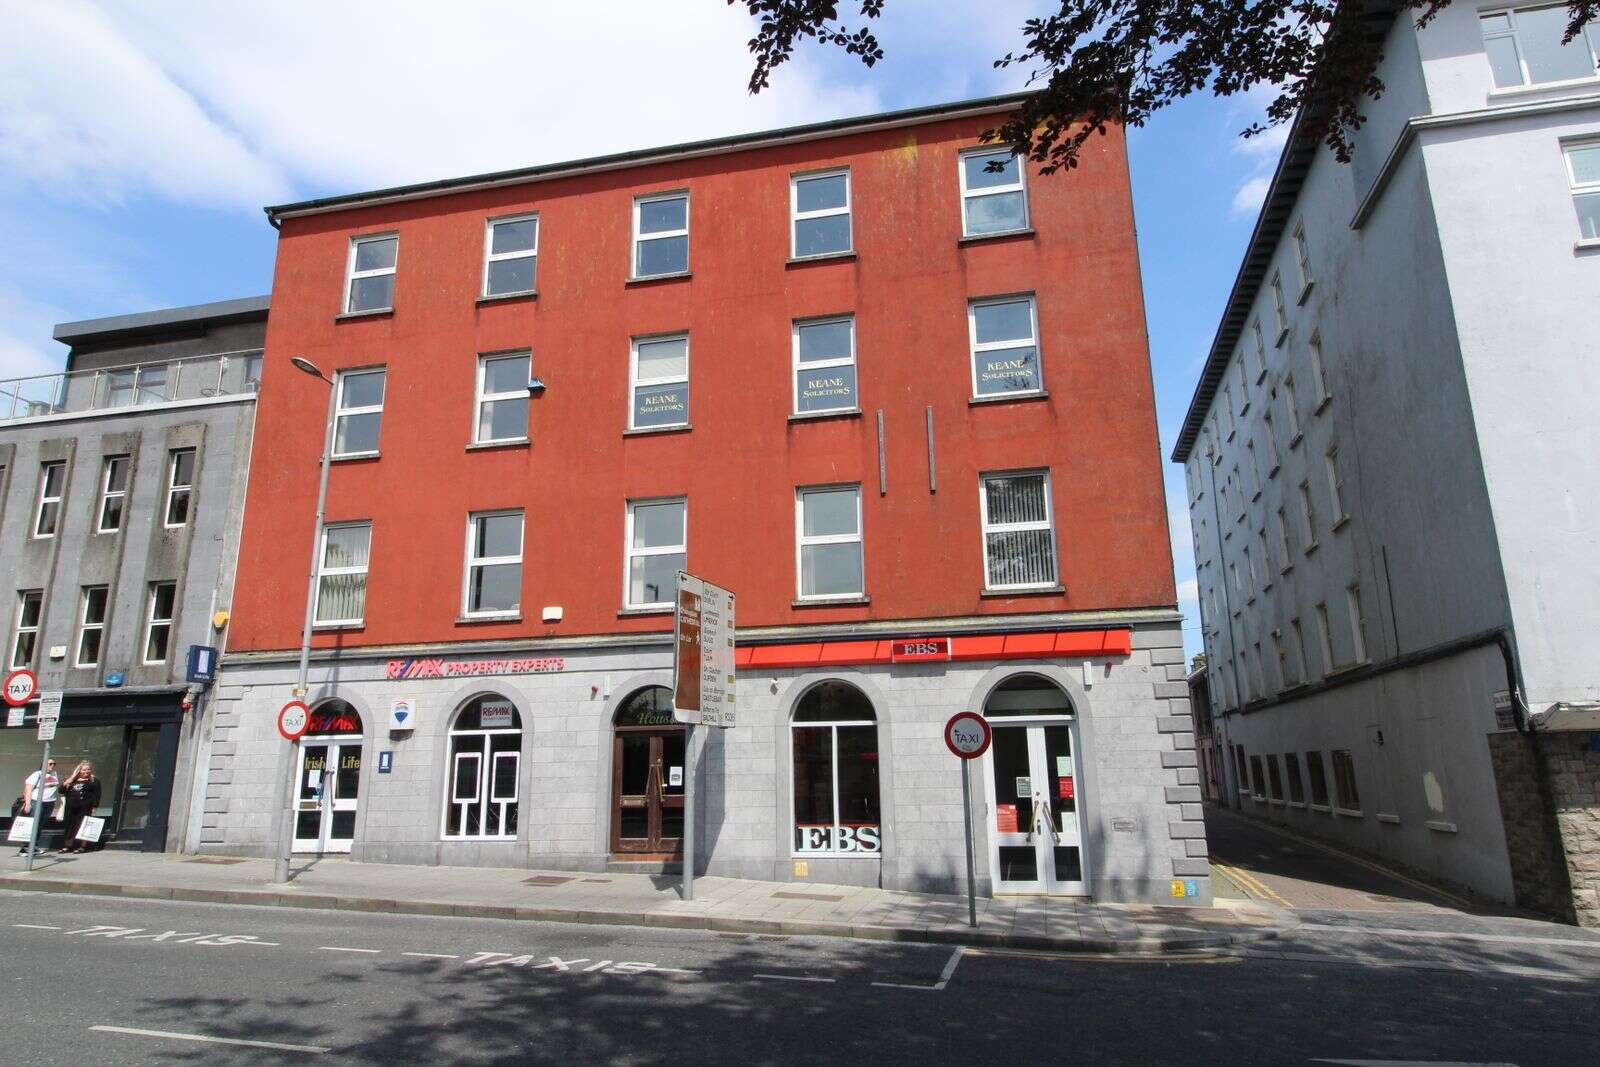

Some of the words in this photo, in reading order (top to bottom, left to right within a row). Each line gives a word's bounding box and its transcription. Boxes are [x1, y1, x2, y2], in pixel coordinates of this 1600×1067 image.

[984, 359, 1024, 371] KEANE
[982, 368, 1032, 381] SOLICITORS
[808, 378, 843, 389] KEANE
[803, 386, 850, 399] SOLICITORS
[645, 395, 678, 405] KEANE
[639, 403, 684, 415] SOLICITORS
[904, 643, 938, 655] EBS
[385, 657, 445, 679] RE/MAX
[446, 661, 510, 676] PROPERTY
[512, 656, 567, 673] EXPERTS
[9, 684, 31, 694] TAXI
[482, 706, 511, 716] RE/MAX
[285, 717, 302, 727] TAXI
[955, 733, 979, 744] TAXI
[304, 757, 325, 769] Irish
[342, 756, 360, 769] Life
[798, 826, 880, 852] EBS
[64, 925, 262, 946] TAXIS
[464, 951, 662, 974] TAXIS
